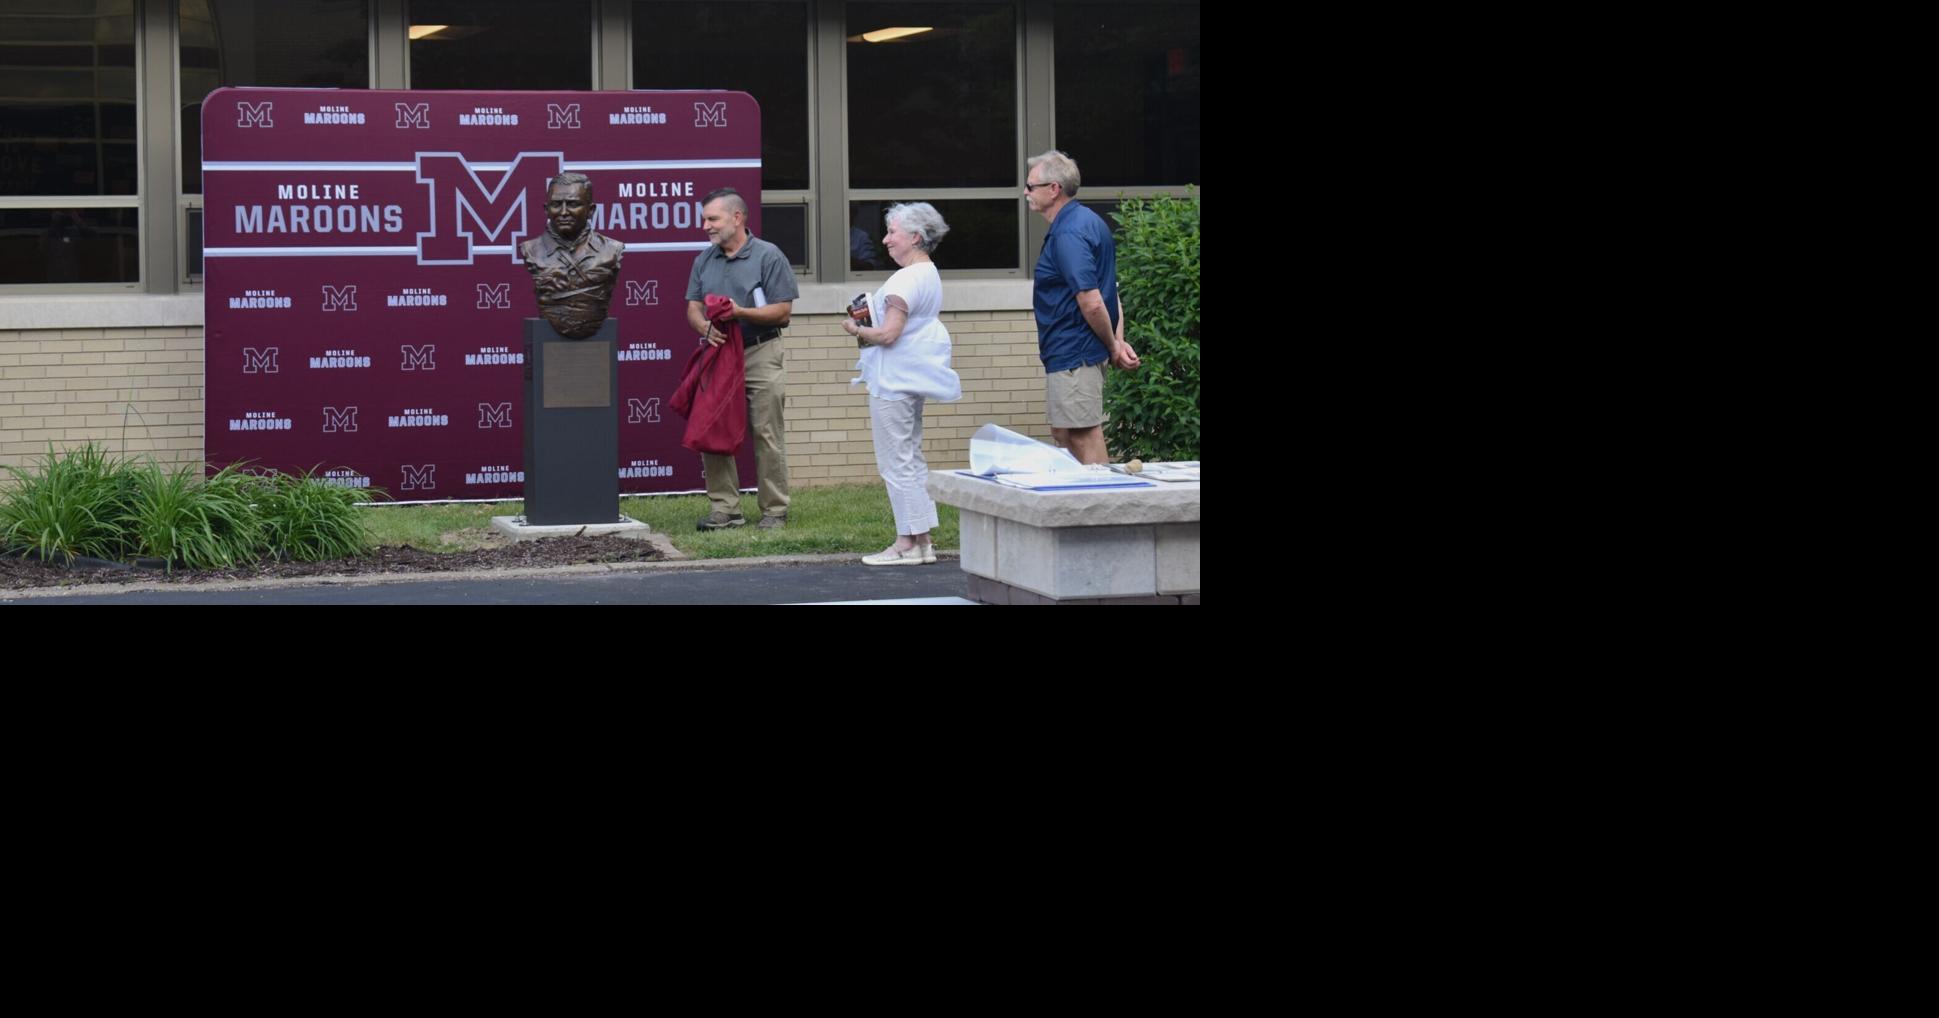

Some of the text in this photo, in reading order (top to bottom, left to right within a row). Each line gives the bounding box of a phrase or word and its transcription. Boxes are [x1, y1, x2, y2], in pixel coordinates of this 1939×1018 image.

[237, 101, 274, 129] M
[303, 112, 366, 125] MAROONS
[394, 102, 430, 129] M
[459, 113, 519, 126] MAROONS
[547, 103, 581, 130] M
[609, 112, 667, 125] MAROONS
[693, 101, 728, 128] M
[279, 185, 358, 199] MOLINE
[619, 182, 693, 197] MOLINE
[235, 205, 402, 233] MAROONS
[415, 152, 563, 265] M
[588, 202, 704, 230] MAROO
[229, 296, 292, 309] MAROONS
[245, 289, 275, 297] MOLINE
[321, 284, 358, 312] M
[386, 294, 448, 307] MAROONS
[476, 282, 511, 310] M
[625, 279, 659, 306] M
[242, 346, 279, 374] M
[309, 356, 371, 369] MAROONS
[400, 344, 436, 371] M
[465, 353, 525, 366] MAROONS
[322, 406, 358, 433] M
[387, 414, 449, 428] MAROONS
[478, 401, 513, 429] M
[627, 397, 661, 424] M
[229, 418, 292, 431] MAROONS
[325, 469, 354, 477] MOLINE
[400, 463, 436, 491] M
[465, 471, 526, 485] MAROONS
